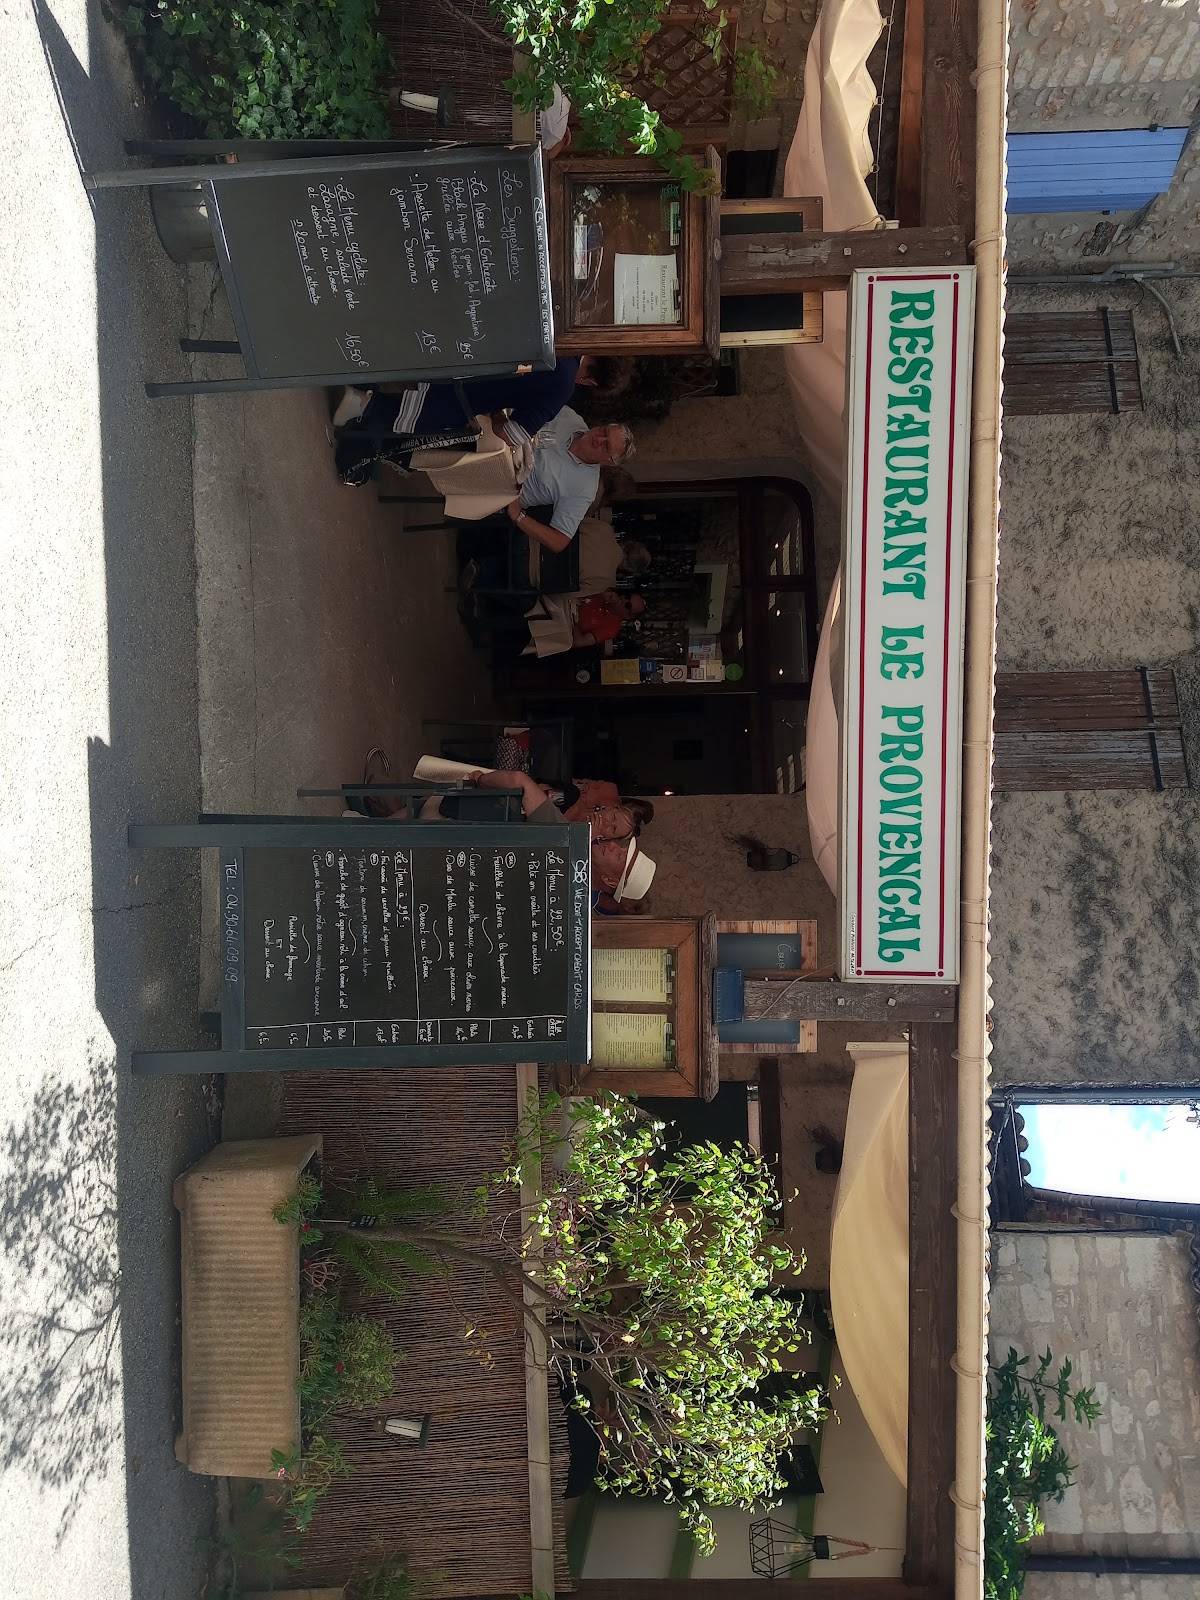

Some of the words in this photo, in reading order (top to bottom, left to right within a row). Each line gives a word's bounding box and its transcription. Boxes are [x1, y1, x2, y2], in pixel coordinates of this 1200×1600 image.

[307, 186, 317, 199] et
[336, 184, 355, 202] Le
[450, 177, 469, 211] Black
[470, 177, 488, 198] La
[502, 170, 523, 198] Les
[389, 188, 413, 231] jambon
[410, 182, 434, 223] Assiette
[310, 205, 325, 240] dessert
[338, 206, 358, 236] Menu
[473, 202, 492, 229] Noix
[423, 227, 435, 241] de
[445, 221, 455, 242] aux
[454, 213, 469, 244] Angus
[536, 225, 544, 242] NOUS
[320, 247, 329, 262] au
[421, 244, 441, 274] Melon
[478, 235, 498, 295] d'Entrecôte
[303, 265, 321, 305] d'attente
[334, 249, 351, 285] salade
[343, 288, 359, 311] verte
[430, 279, 439, 294] au
[540, 292, 548, 308] PAS
[421, 329, 442, 354] 13€
[542, 322, 550, 344] CARTES
[343, 331, 370, 368] 16,50€
[882, 289, 935, 600] RESTAURANT
[880, 624, 925, 681] LE
[878, 705, 924, 963] PROVENCAL
[396, 851, 408, 864] Le
[445, 854, 457, 872] Dos
[547, 851, 563, 865] Le
[393, 867, 407, 887] Menu
[446, 875, 456, 885] de
[492, 856, 504, 888] Feuilleté
[527, 860, 540, 879] Pâté
[315, 879, 325, 889] de
[340, 883, 349, 892] de
[359, 885, 367, 894] de
[380, 886, 390, 894] de
[468, 881, 479, 892] de
[529, 881, 536, 891] en
[547, 868, 564, 893] Menu
[495, 891, 506, 900] de
[549, 896, 561, 904] à
[575, 888, 584, 900] WE
[468, 895, 480, 924] canette
[495, 903, 506, 929] chèvre
[530, 895, 540, 918] croûte
[288, 915, 298, 942] Assiette
[419, 903, 431, 934] Dessert
[531, 920, 539, 928] et
[263, 920, 275, 945] Dessert
[574, 925, 583, 952] ACCEPT
[265, 947, 271, 958] au
[276, 938, 282, 950] ET
[289, 944, 299, 953] de
[420, 939, 427, 951] au
[498, 942, 508, 951] la
[284, 954, 299, 981] fromage
[467, 953, 475, 969] aux
